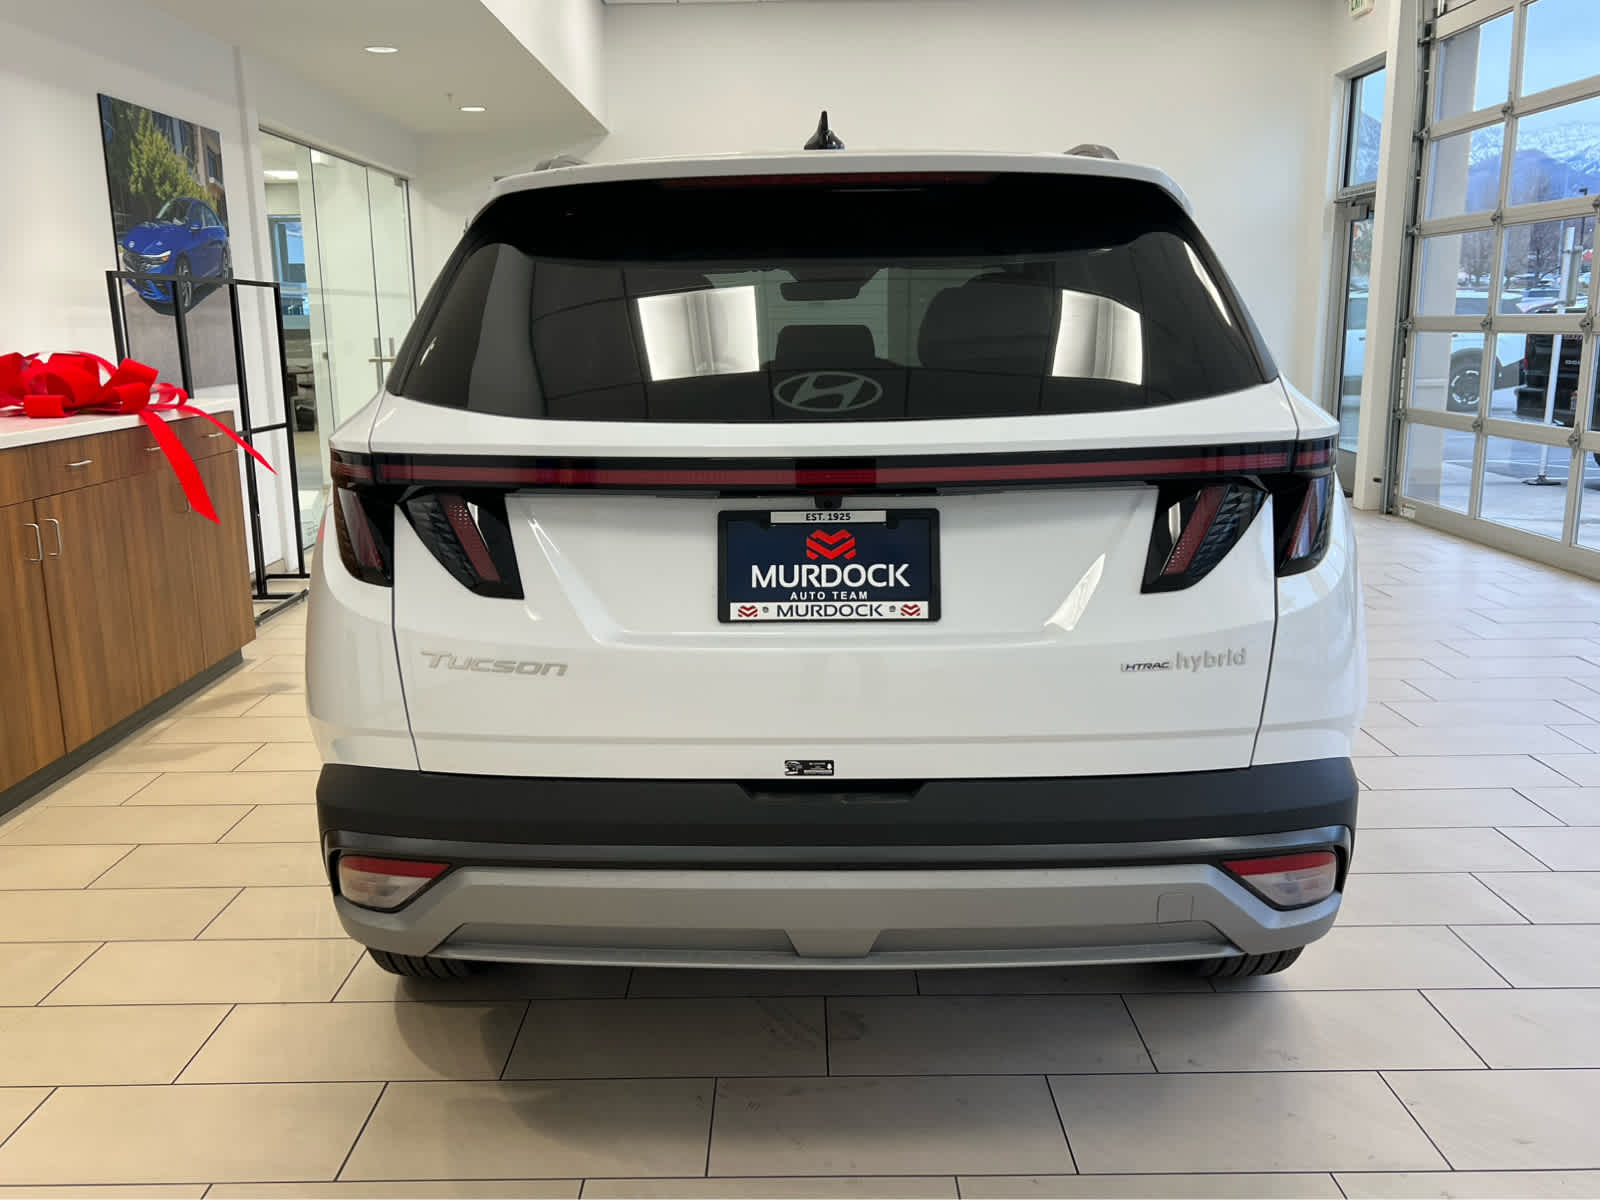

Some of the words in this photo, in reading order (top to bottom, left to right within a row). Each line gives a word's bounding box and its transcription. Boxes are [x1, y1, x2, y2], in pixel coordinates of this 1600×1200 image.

[805, 513, 826, 521] EST.
[828, 513, 851, 521] 1925
[751, 563, 911, 588] MURDOCK
[790, 591, 826, 600] AUTO
[832, 591, 868, 600] TEAM
[776, 603, 884, 617] MURDOCK
[1122, 661, 1170, 672] HTRAC
[1175, 647, 1247, 673] hybrid
